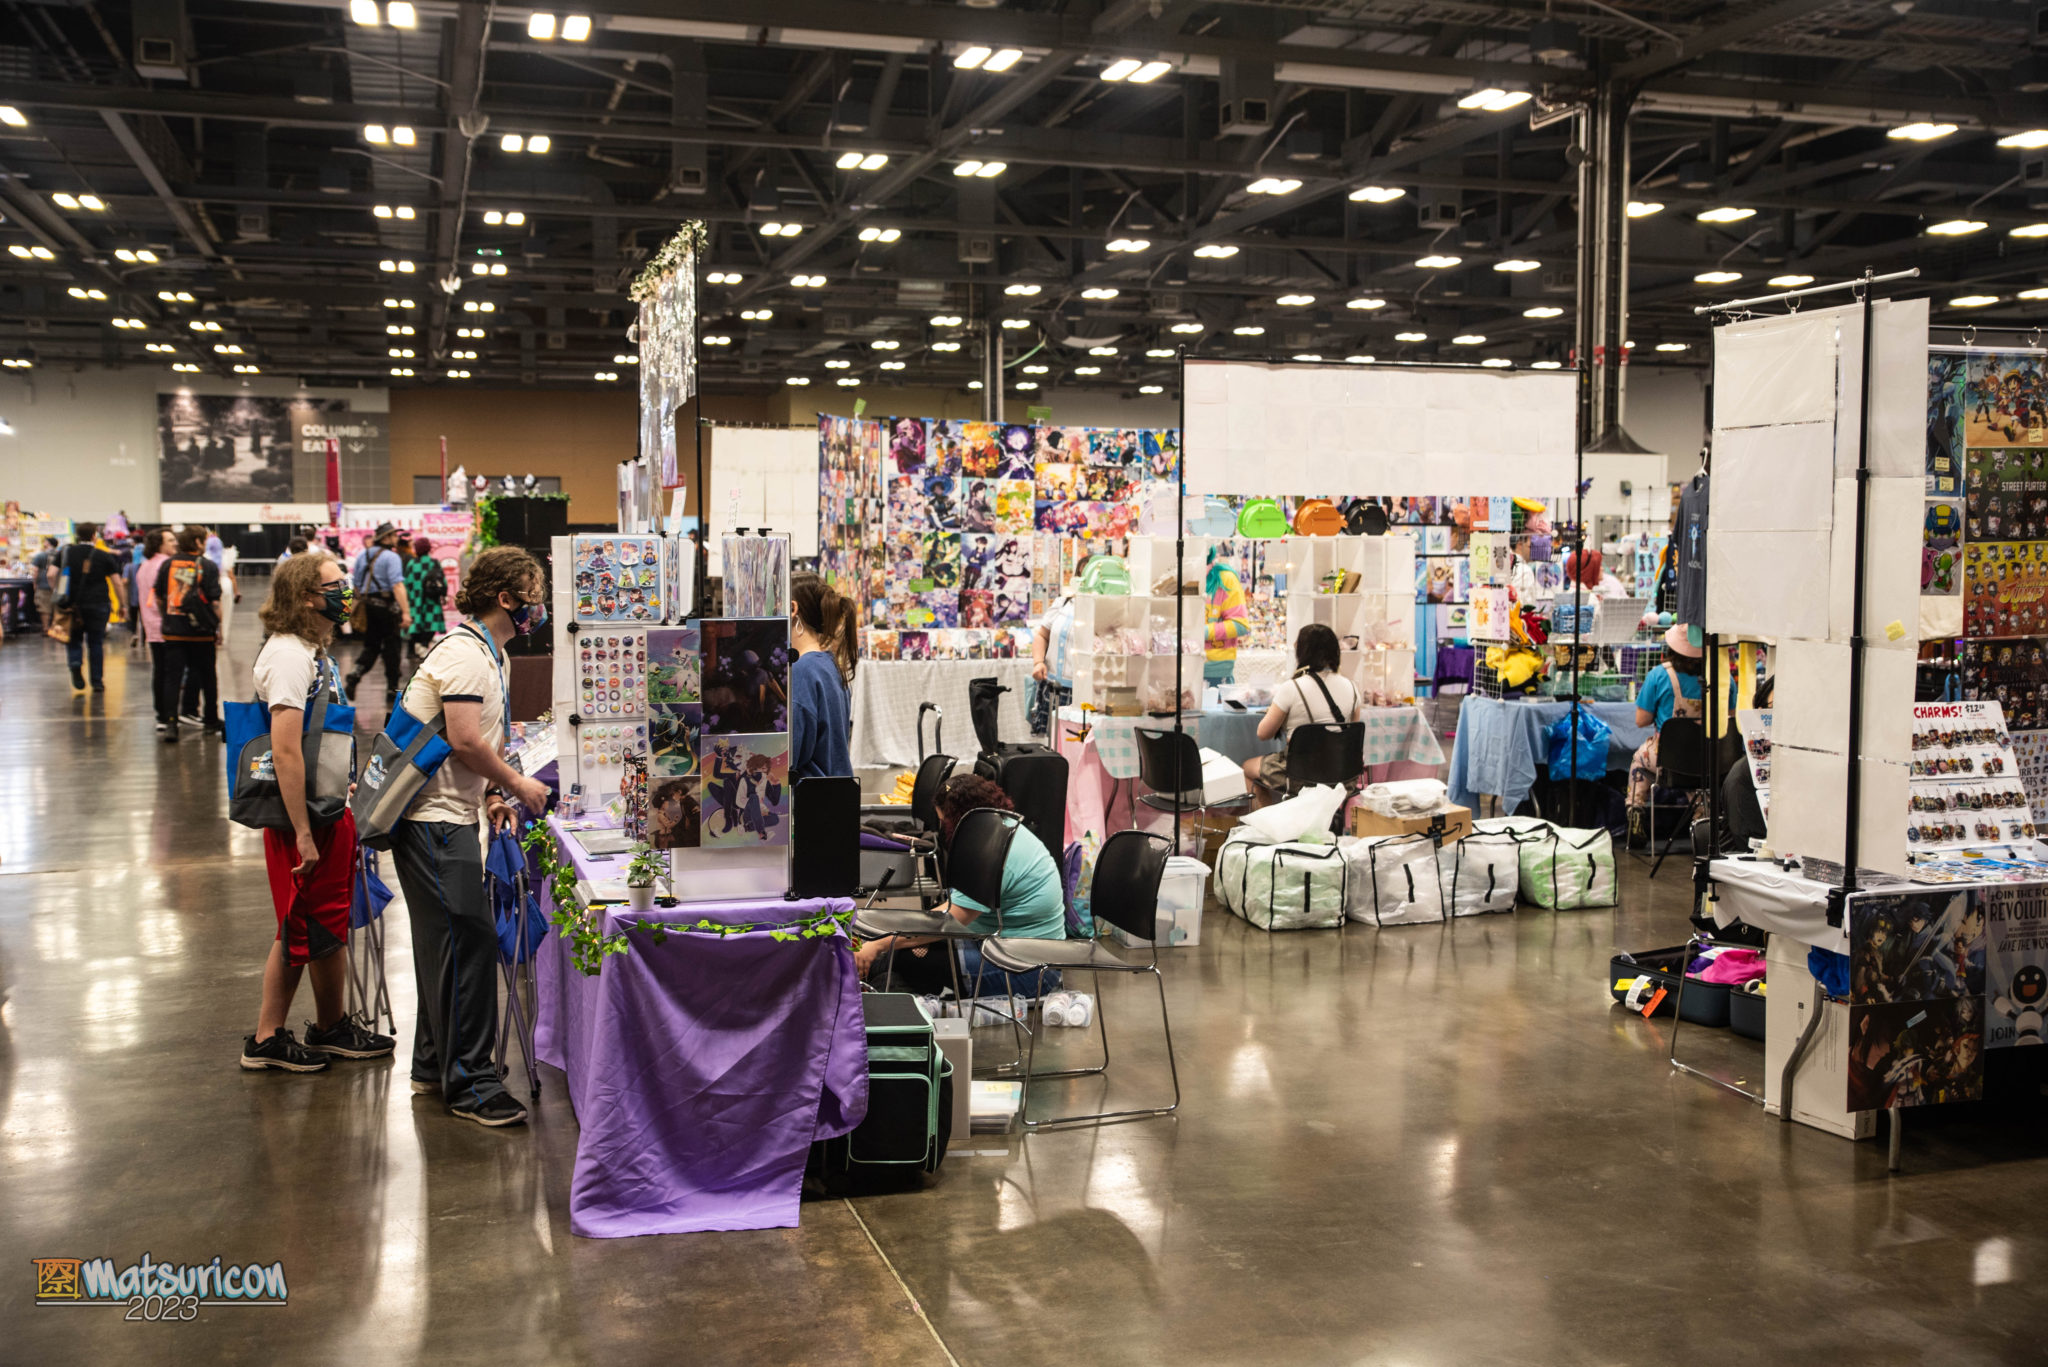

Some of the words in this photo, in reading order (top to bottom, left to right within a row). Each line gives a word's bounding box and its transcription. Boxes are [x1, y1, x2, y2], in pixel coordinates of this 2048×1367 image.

[302, 424, 378, 437] COLUMBUS
[2001, 481, 2023, 492] STREET
[1913, 705, 1963, 719] CHARMS!
[1990, 889, 2014, 901] JOIN
[2017, 888, 2033, 898] THE
[1990, 899, 2047, 921] REVOLUTI
[1990, 1026, 2016, 1042] JOIN
